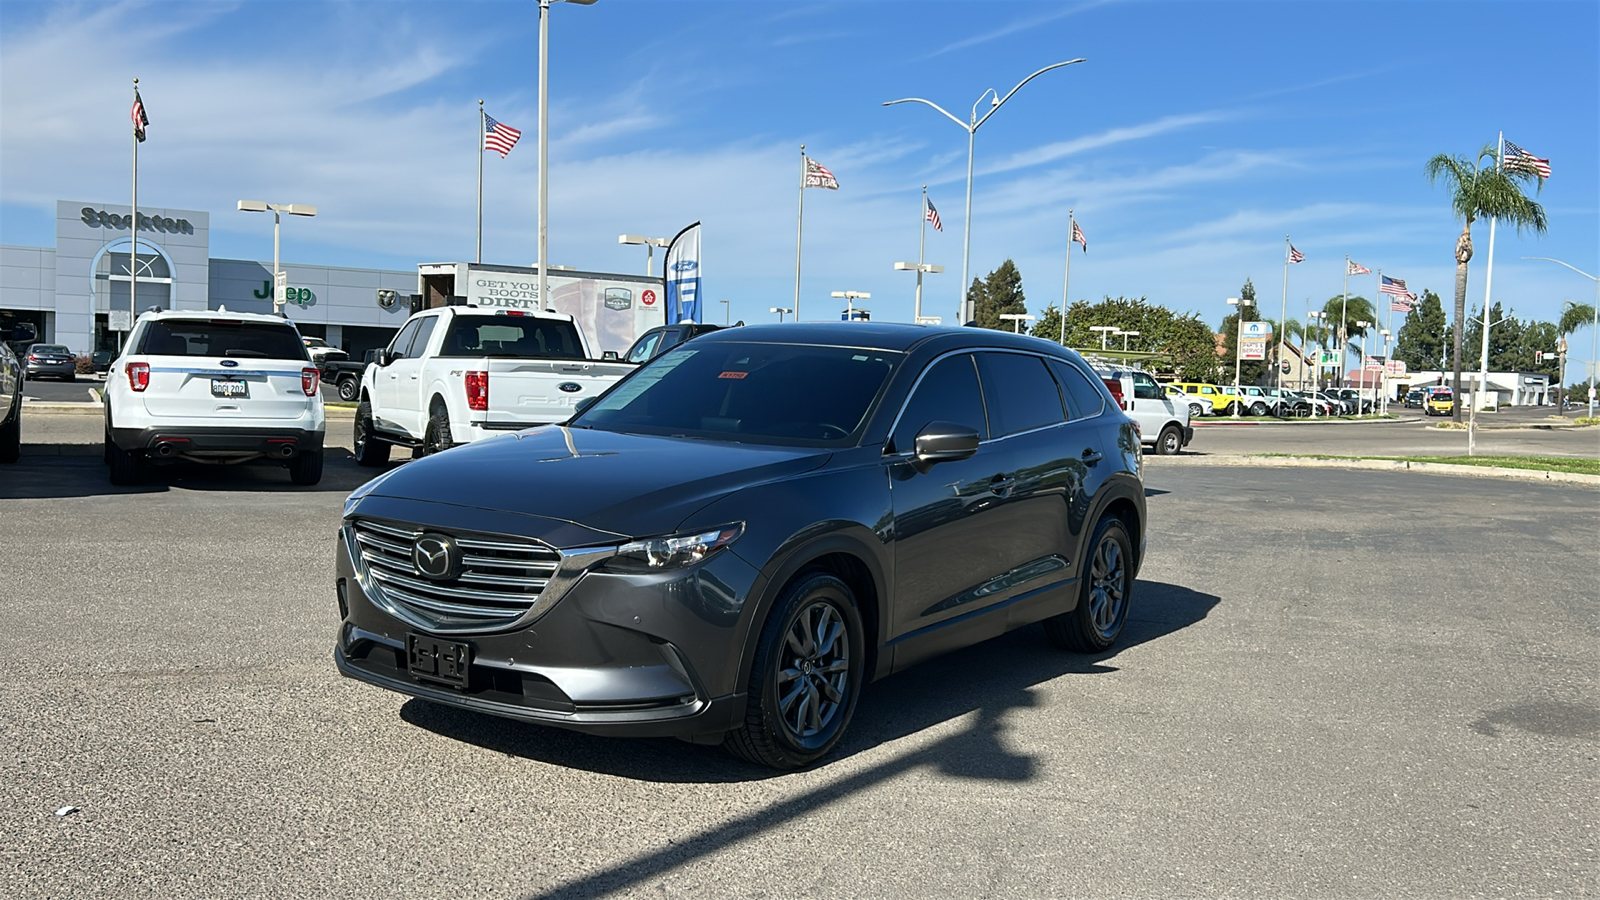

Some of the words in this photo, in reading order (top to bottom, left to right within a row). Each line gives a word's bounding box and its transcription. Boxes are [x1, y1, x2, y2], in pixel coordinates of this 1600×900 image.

[81, 207, 193, 235] Stockton
[476, 280, 507, 289] GET
[488, 289, 539, 299] BOOTS
[478, 296, 548, 310] DIRT
